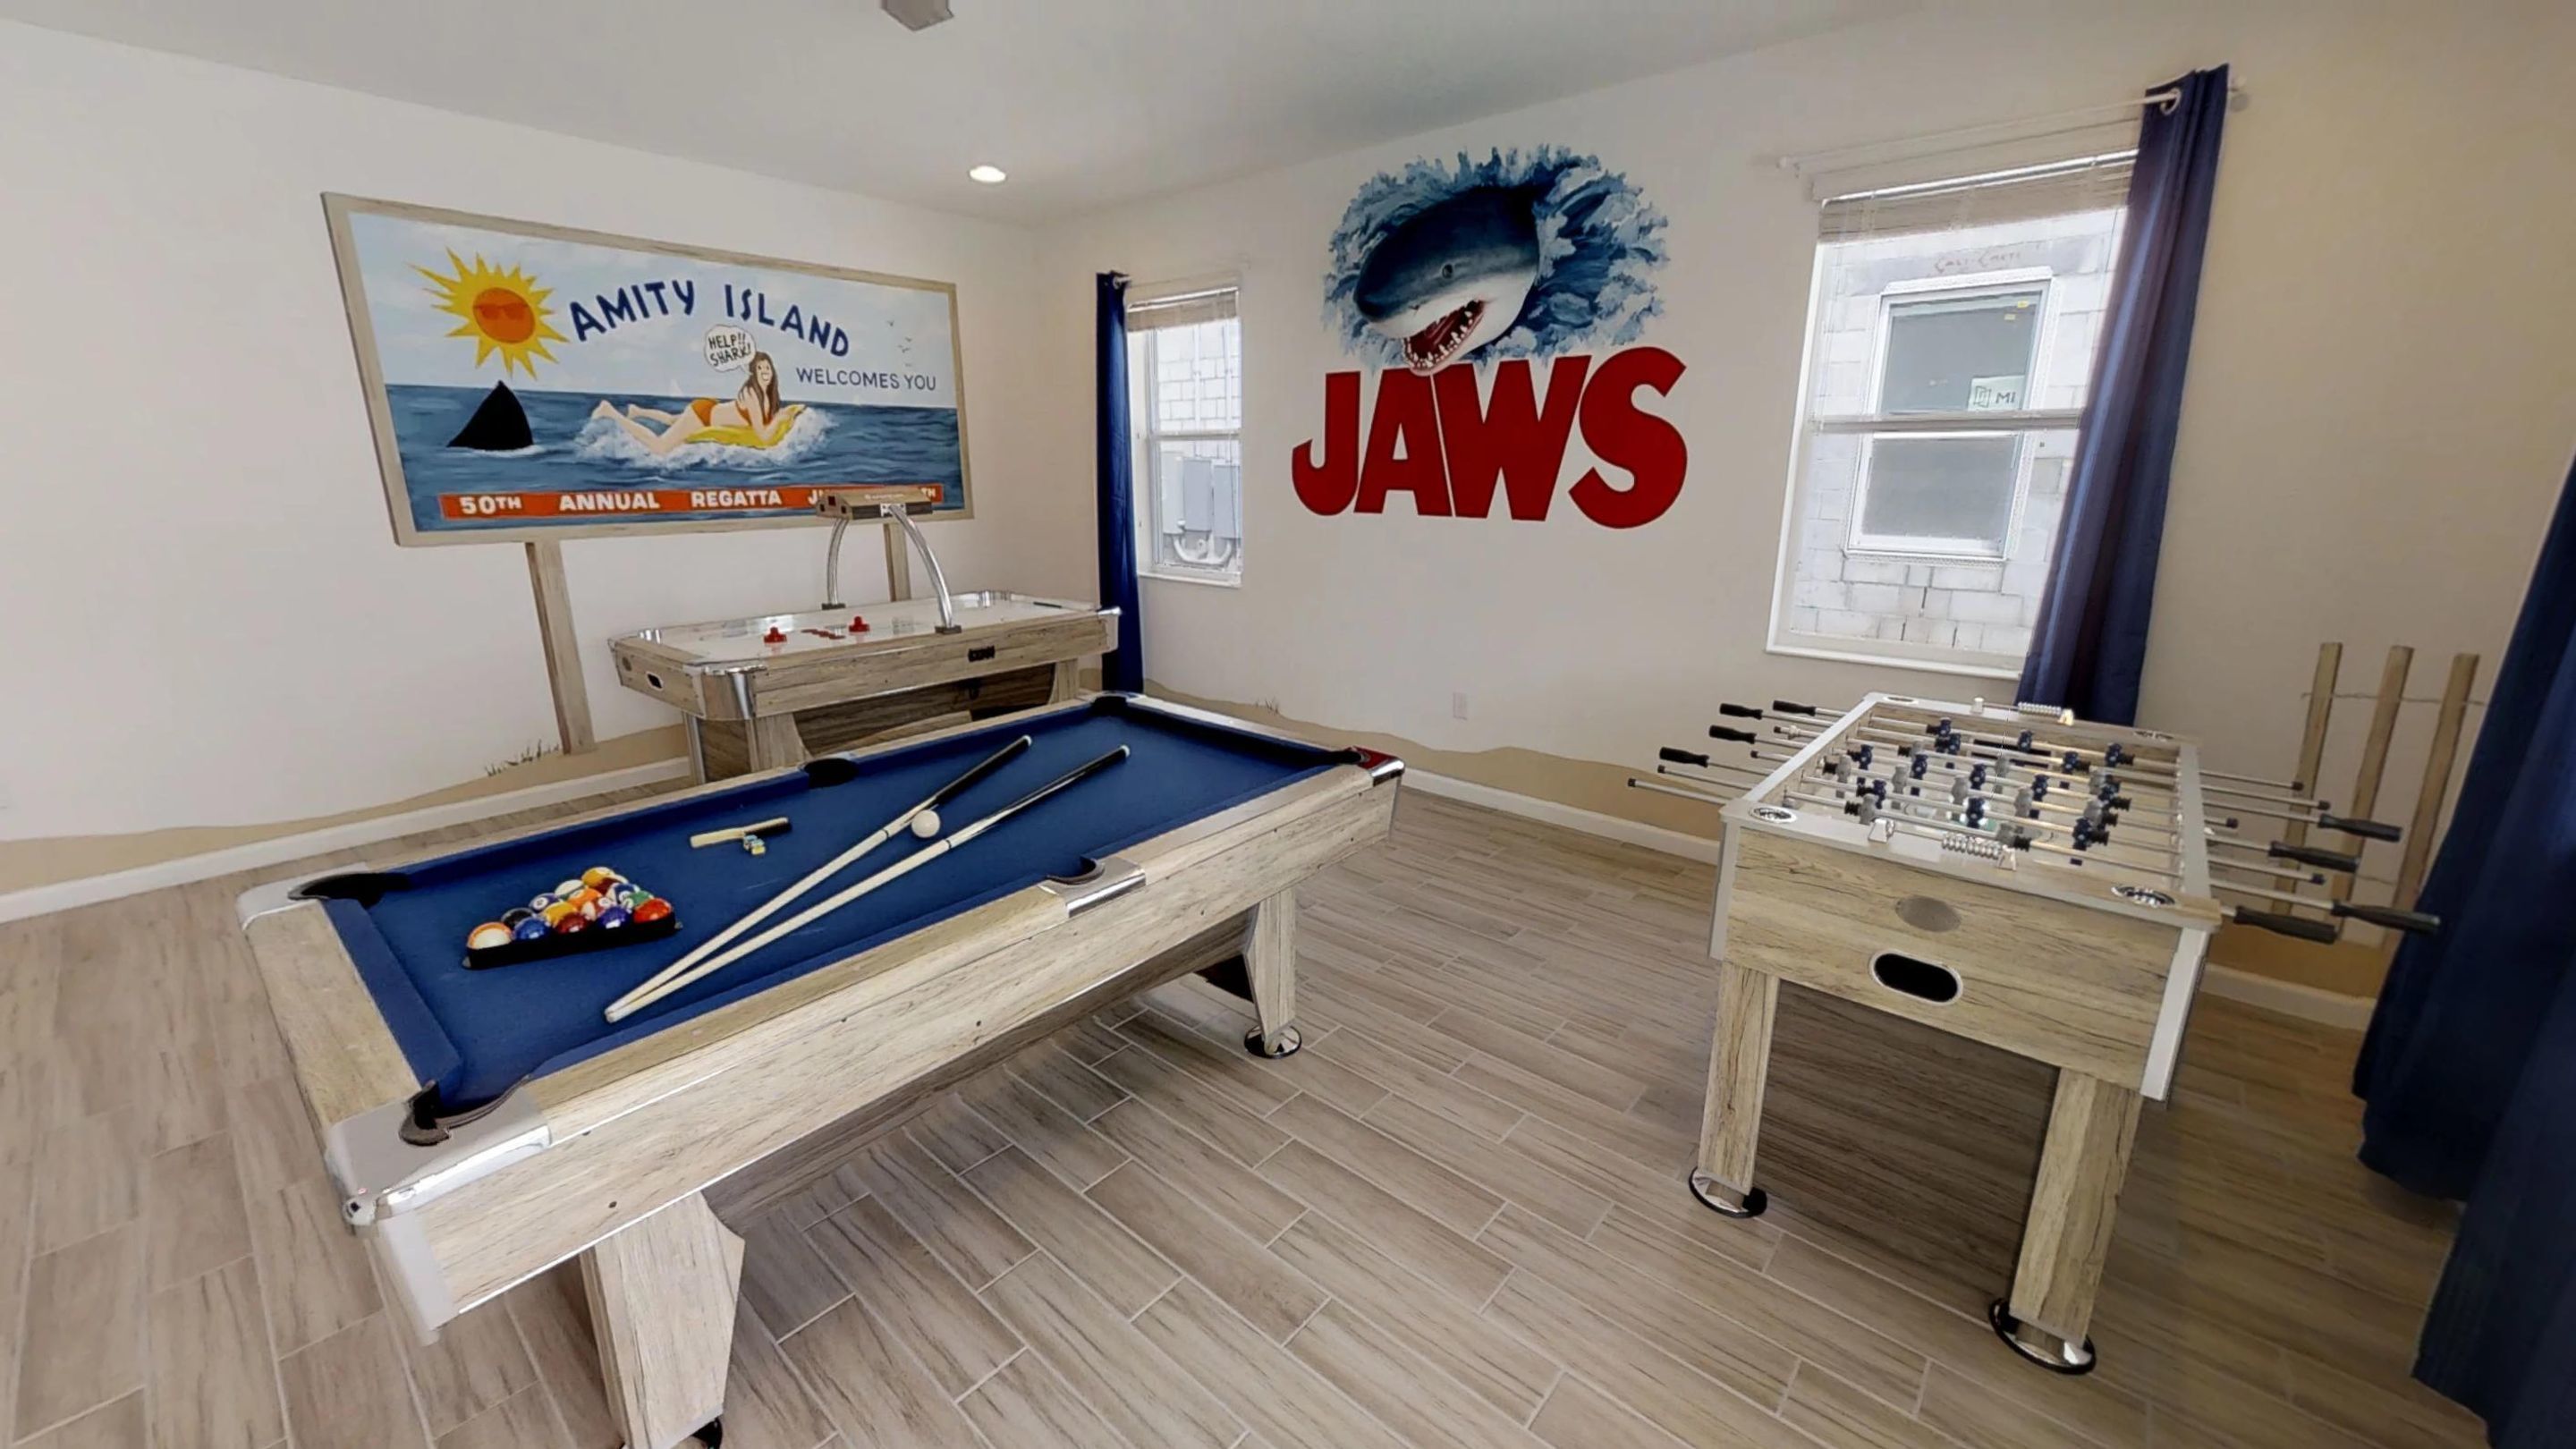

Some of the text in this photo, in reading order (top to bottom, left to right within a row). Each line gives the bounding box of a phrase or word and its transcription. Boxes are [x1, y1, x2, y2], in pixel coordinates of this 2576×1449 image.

[569, 279, 850, 357] AMITY ISLAND
[708, 332, 746, 350] HELP!!
[709, 343, 751, 367] SHARK!
[796, 367, 937, 391] WELCOMES YOU
[1292, 345, 1688, 530] JAWS
[459, 495, 522, 515] 50TH
[559, 492, 660, 512] ANNUAL
[690, 489, 783, 508] REGATTA
